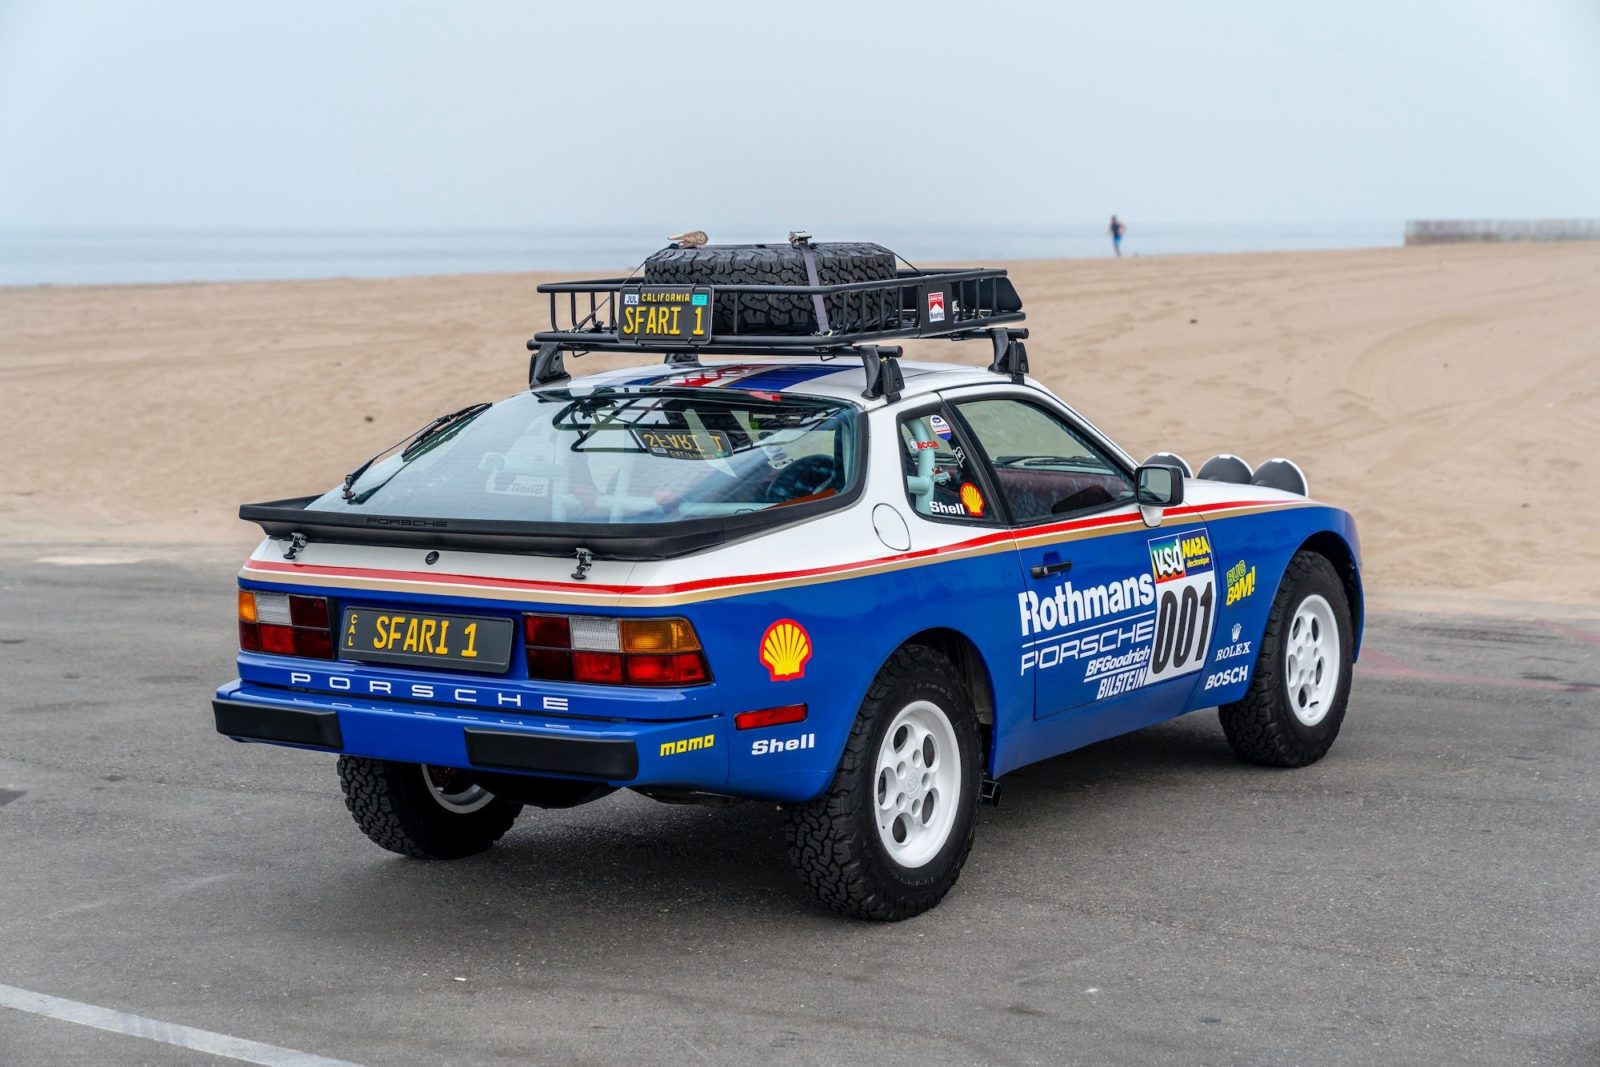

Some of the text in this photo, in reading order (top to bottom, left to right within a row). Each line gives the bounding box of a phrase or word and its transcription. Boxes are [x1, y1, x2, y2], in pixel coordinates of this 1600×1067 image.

[641, 293, 690, 302] CALIFORNIA
[623, 306, 704, 335] SFARI 1
[366, 517, 448, 528] PORSCHE
[929, 501, 965, 515] Shell
[1225, 565, 1256, 606] BAM!
[1226, 559, 1246, 587] BUG
[1018, 572, 1155, 637] Rothmans
[349, 613, 358, 648] CAL
[373, 615, 478, 658] SFARI 1
[1152, 581, 1213, 675] 001
[1020, 618, 1154, 676] PORSCHE
[1085, 644, 1151, 677] BFGoodrich
[1215, 640, 1252, 662] ROLEX
[290, 672, 569, 711] PORSCHE
[1096, 666, 1148, 700] BILSTEIN
[1204, 664, 1249, 690] BOSCH
[659, 734, 715, 757] momo
[751, 733, 815, 756] Shell
